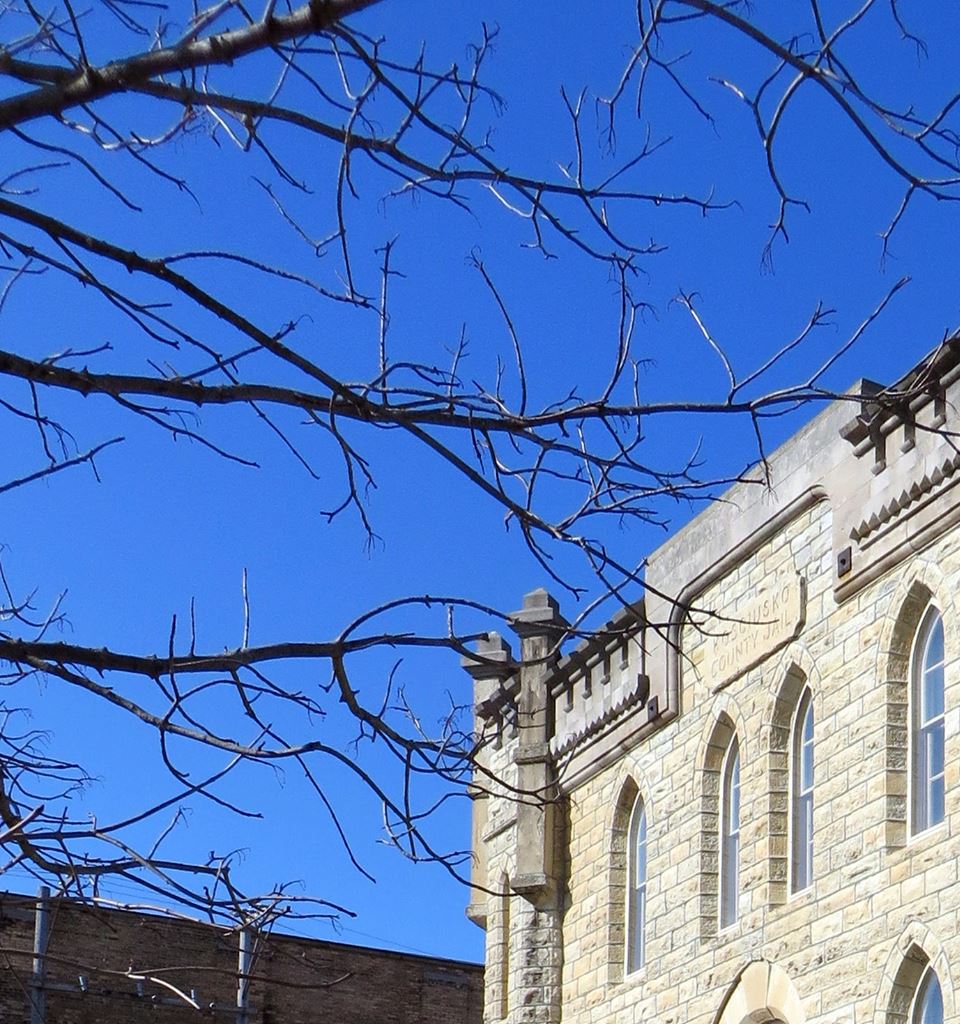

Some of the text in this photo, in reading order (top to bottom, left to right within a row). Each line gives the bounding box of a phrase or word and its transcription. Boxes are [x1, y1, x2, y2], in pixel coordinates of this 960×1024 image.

[711, 609, 791, 678] COUNTY JAIL
[713, 585, 790, 655] KOSCIUSKO
